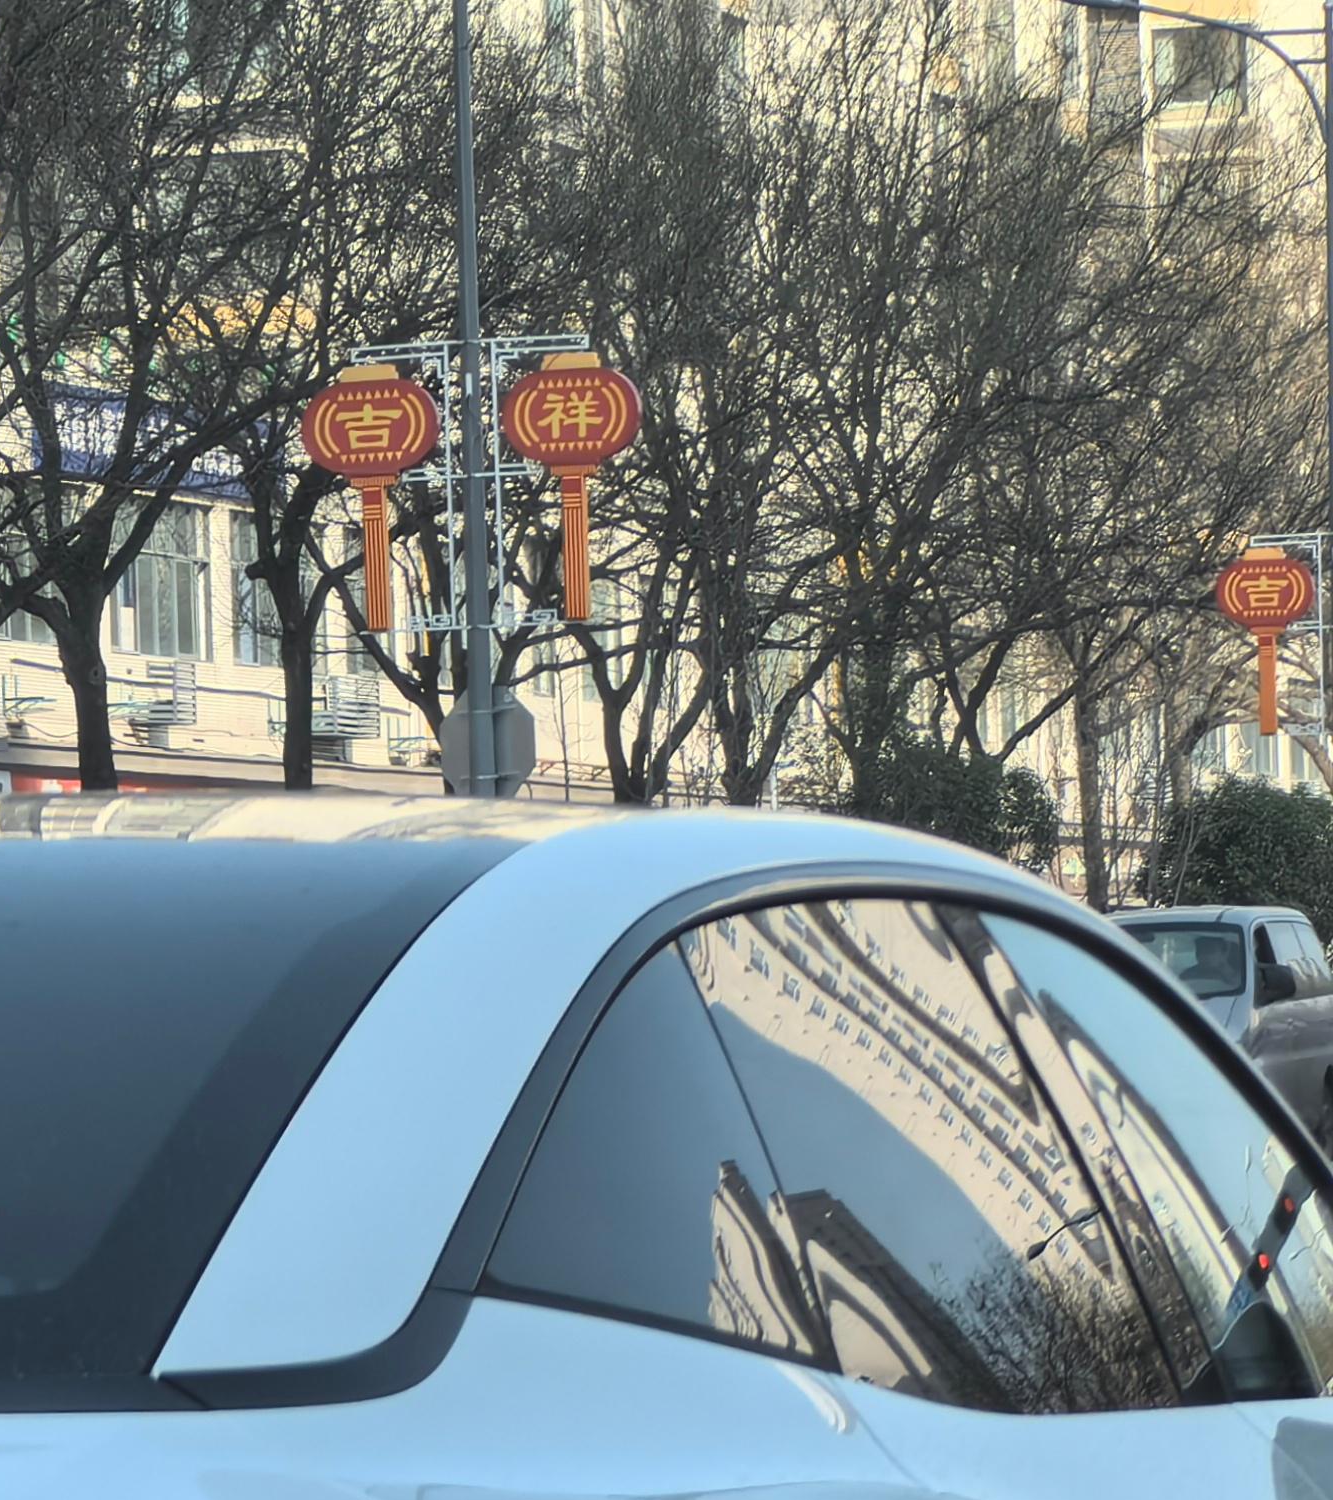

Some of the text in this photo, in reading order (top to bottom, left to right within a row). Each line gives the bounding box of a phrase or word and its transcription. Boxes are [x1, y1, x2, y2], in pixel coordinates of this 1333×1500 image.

[334, 403, 403, 449] 吉
[537, 391, 603, 439] 祥
[1239, 575, 1290, 607] 吉
